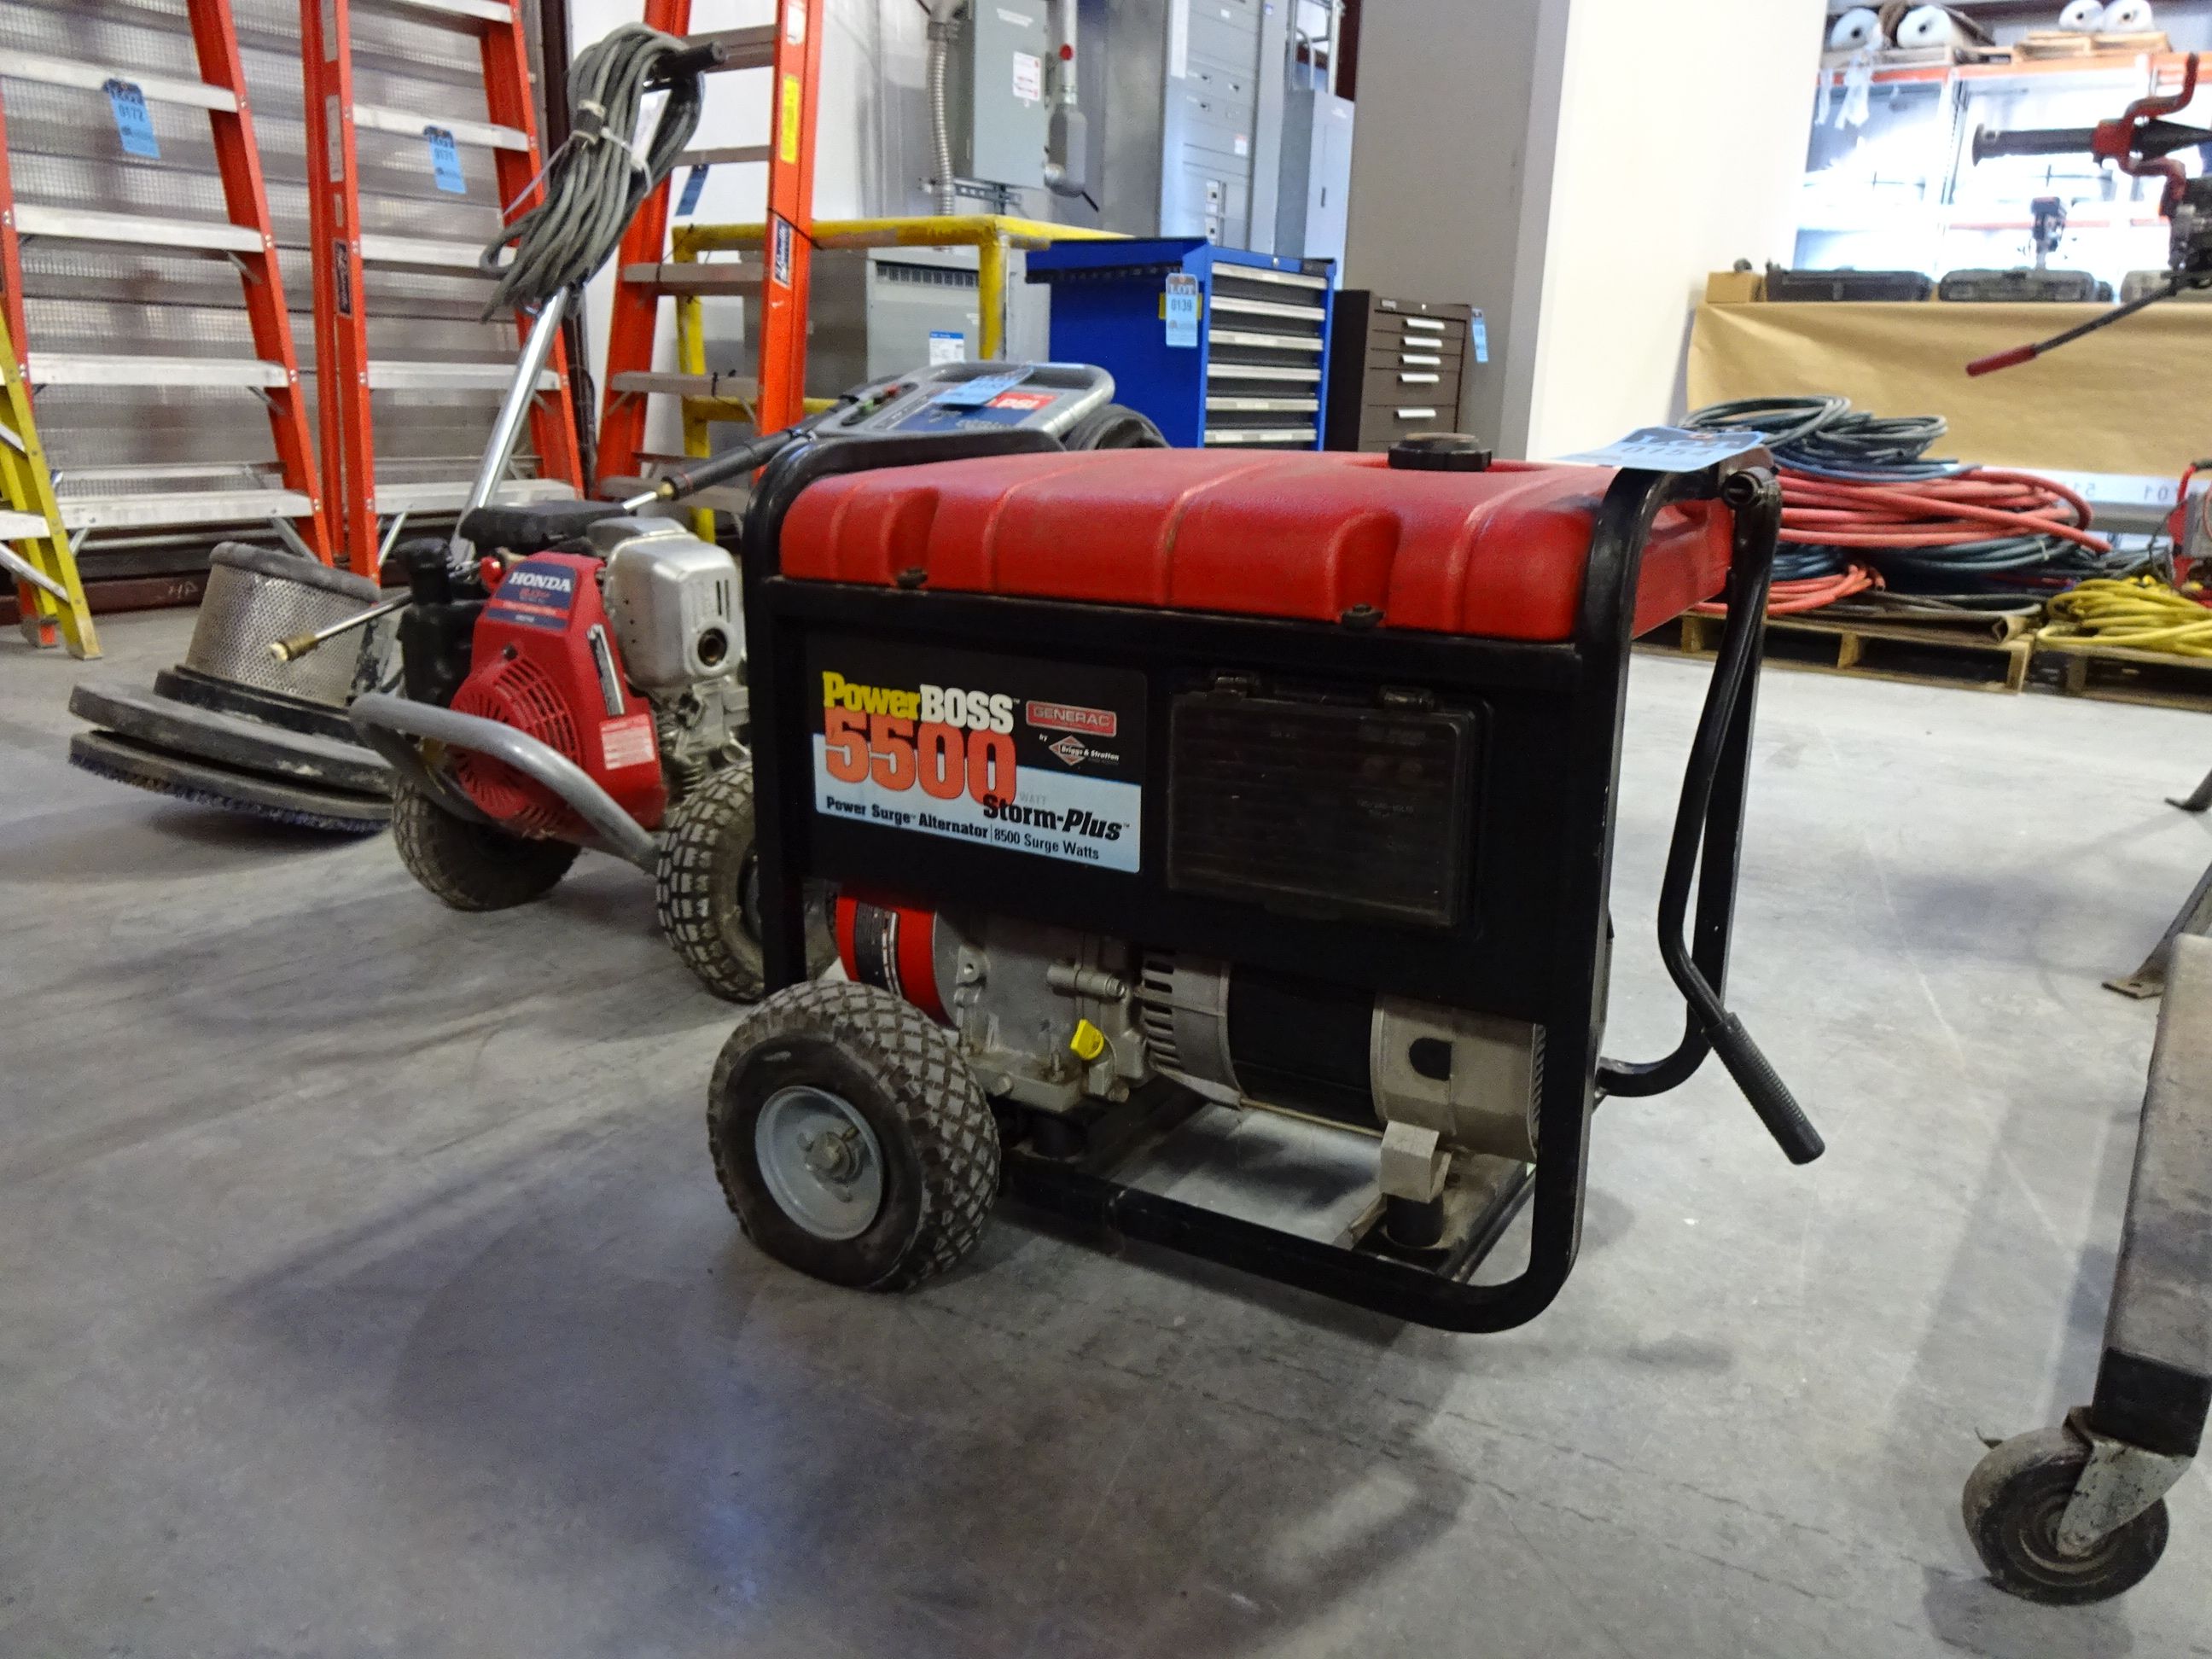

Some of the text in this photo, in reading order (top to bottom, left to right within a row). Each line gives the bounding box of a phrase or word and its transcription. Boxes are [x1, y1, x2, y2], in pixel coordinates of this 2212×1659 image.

[509, 571, 572, 593] HONDA
[822, 671, 1014, 735] PowerBOSS
[1033, 706, 1109, 727] GENERAC
[824, 706, 1016, 806] 5500
[1060, 745, 1084, 757] Briggs
[1084, 748, 1090, 757] &
[1091, 749, 1120, 761] Stratton
[1020, 791, 1046, 806] WATT
[826, 795, 1099, 860] Power Surge Alternator 8500 Surge Watts
[982, 793, 1122, 841] Storm-Plus
